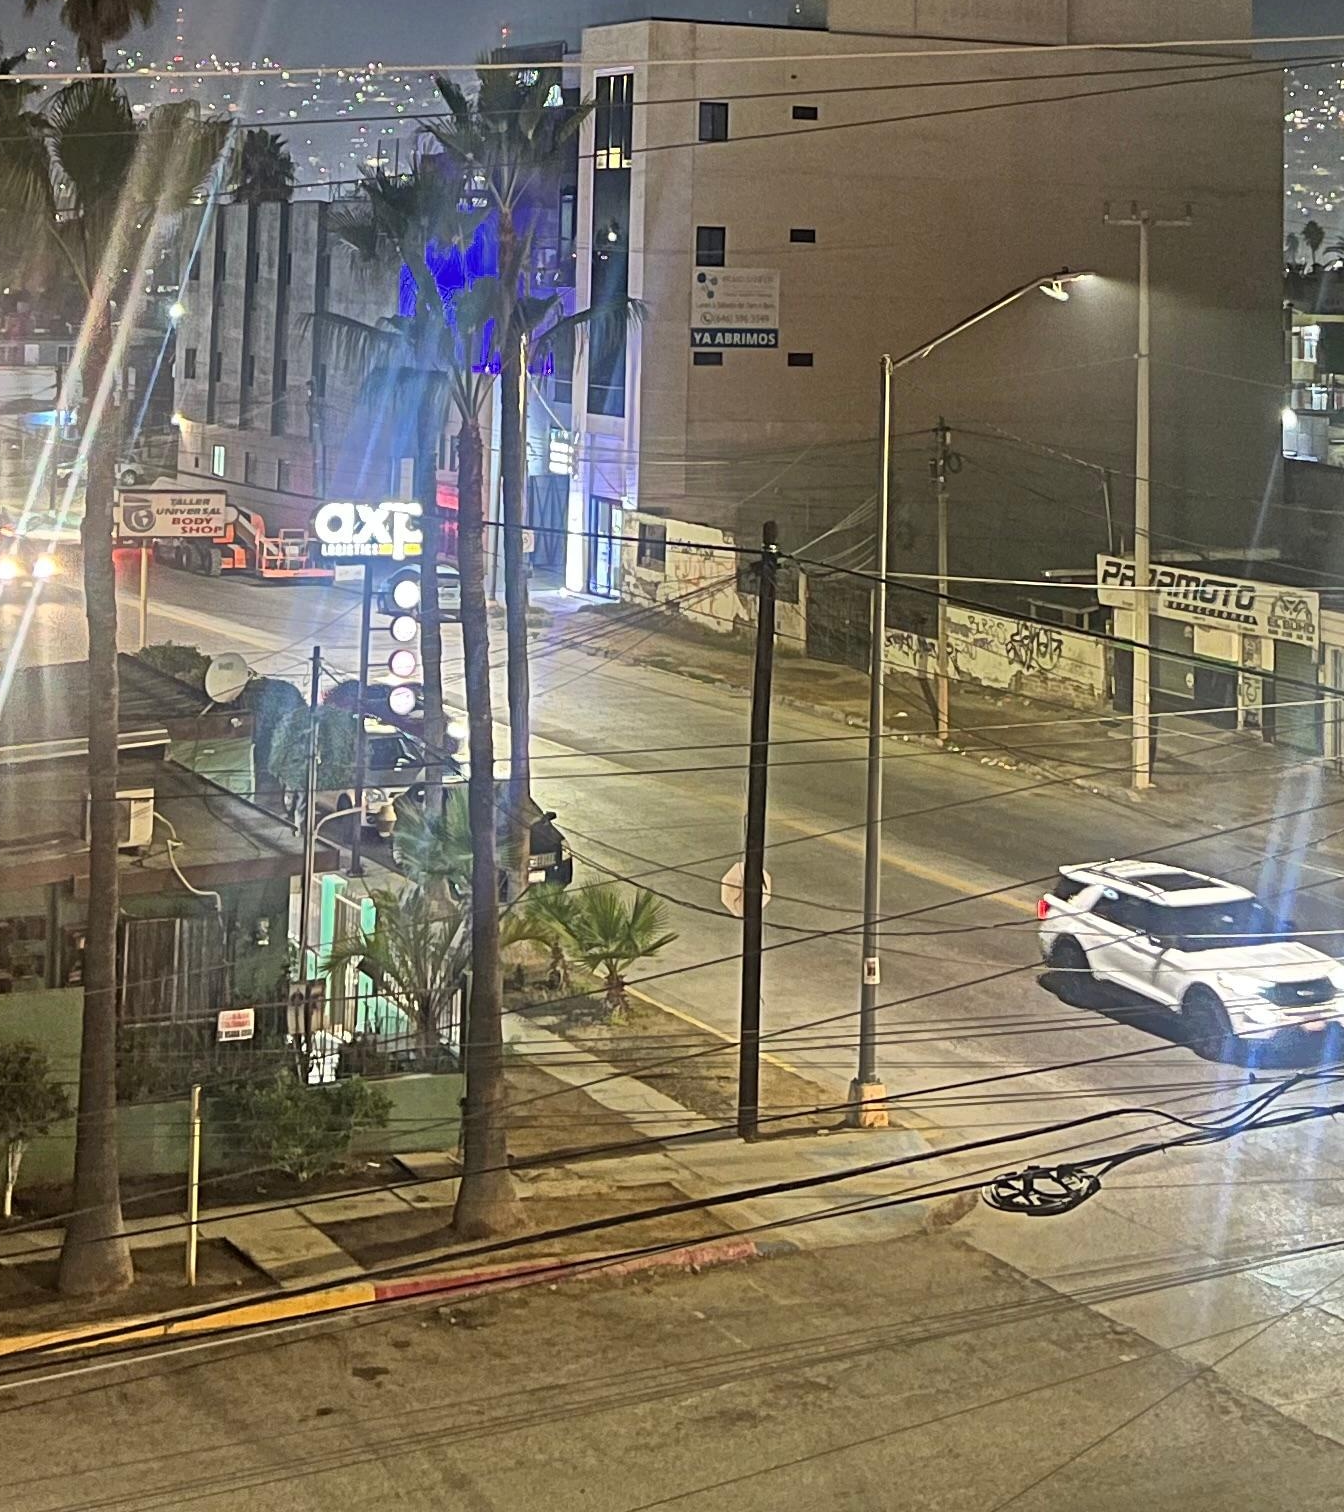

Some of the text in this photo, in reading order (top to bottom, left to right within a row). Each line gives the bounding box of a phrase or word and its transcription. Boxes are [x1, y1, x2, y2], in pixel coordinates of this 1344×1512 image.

[693, 332, 776, 345] YA ABRIMOS
[170, 498, 211, 506] TALLER
[156, 508, 222, 516] UNIVERSAL
[172, 517, 213, 525] BODY
[181, 526, 223, 534] SHOP
